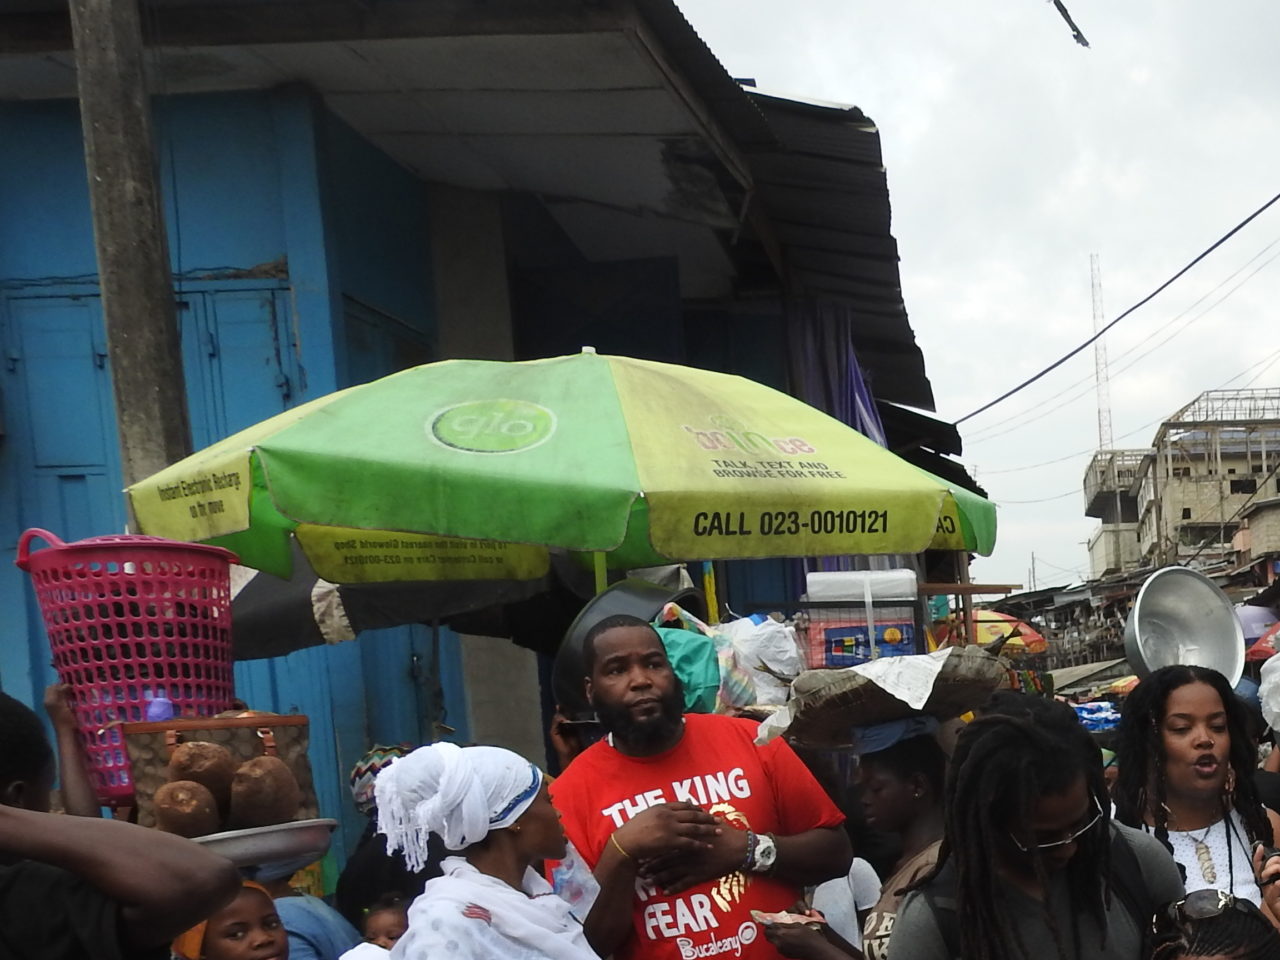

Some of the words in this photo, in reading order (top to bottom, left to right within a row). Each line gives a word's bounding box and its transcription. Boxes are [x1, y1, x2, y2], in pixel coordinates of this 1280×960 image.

[450, 412, 534, 440] glo
[712, 469, 779, 479] BROWSE
[779, 470, 808, 479] FOR
[810, 471, 848, 479] FREE
[756, 461, 795, 470] TEXT
[799, 462, 829, 470] AND
[181, 476, 214, 497] Electronic
[212, 471, 242, 491] Recharge
[693, 511, 752, 537] CALL
[759, 510, 888, 535] 023-0010121
[672, 768, 751, 806] KING
[644, 893, 719, 940] FEAR
